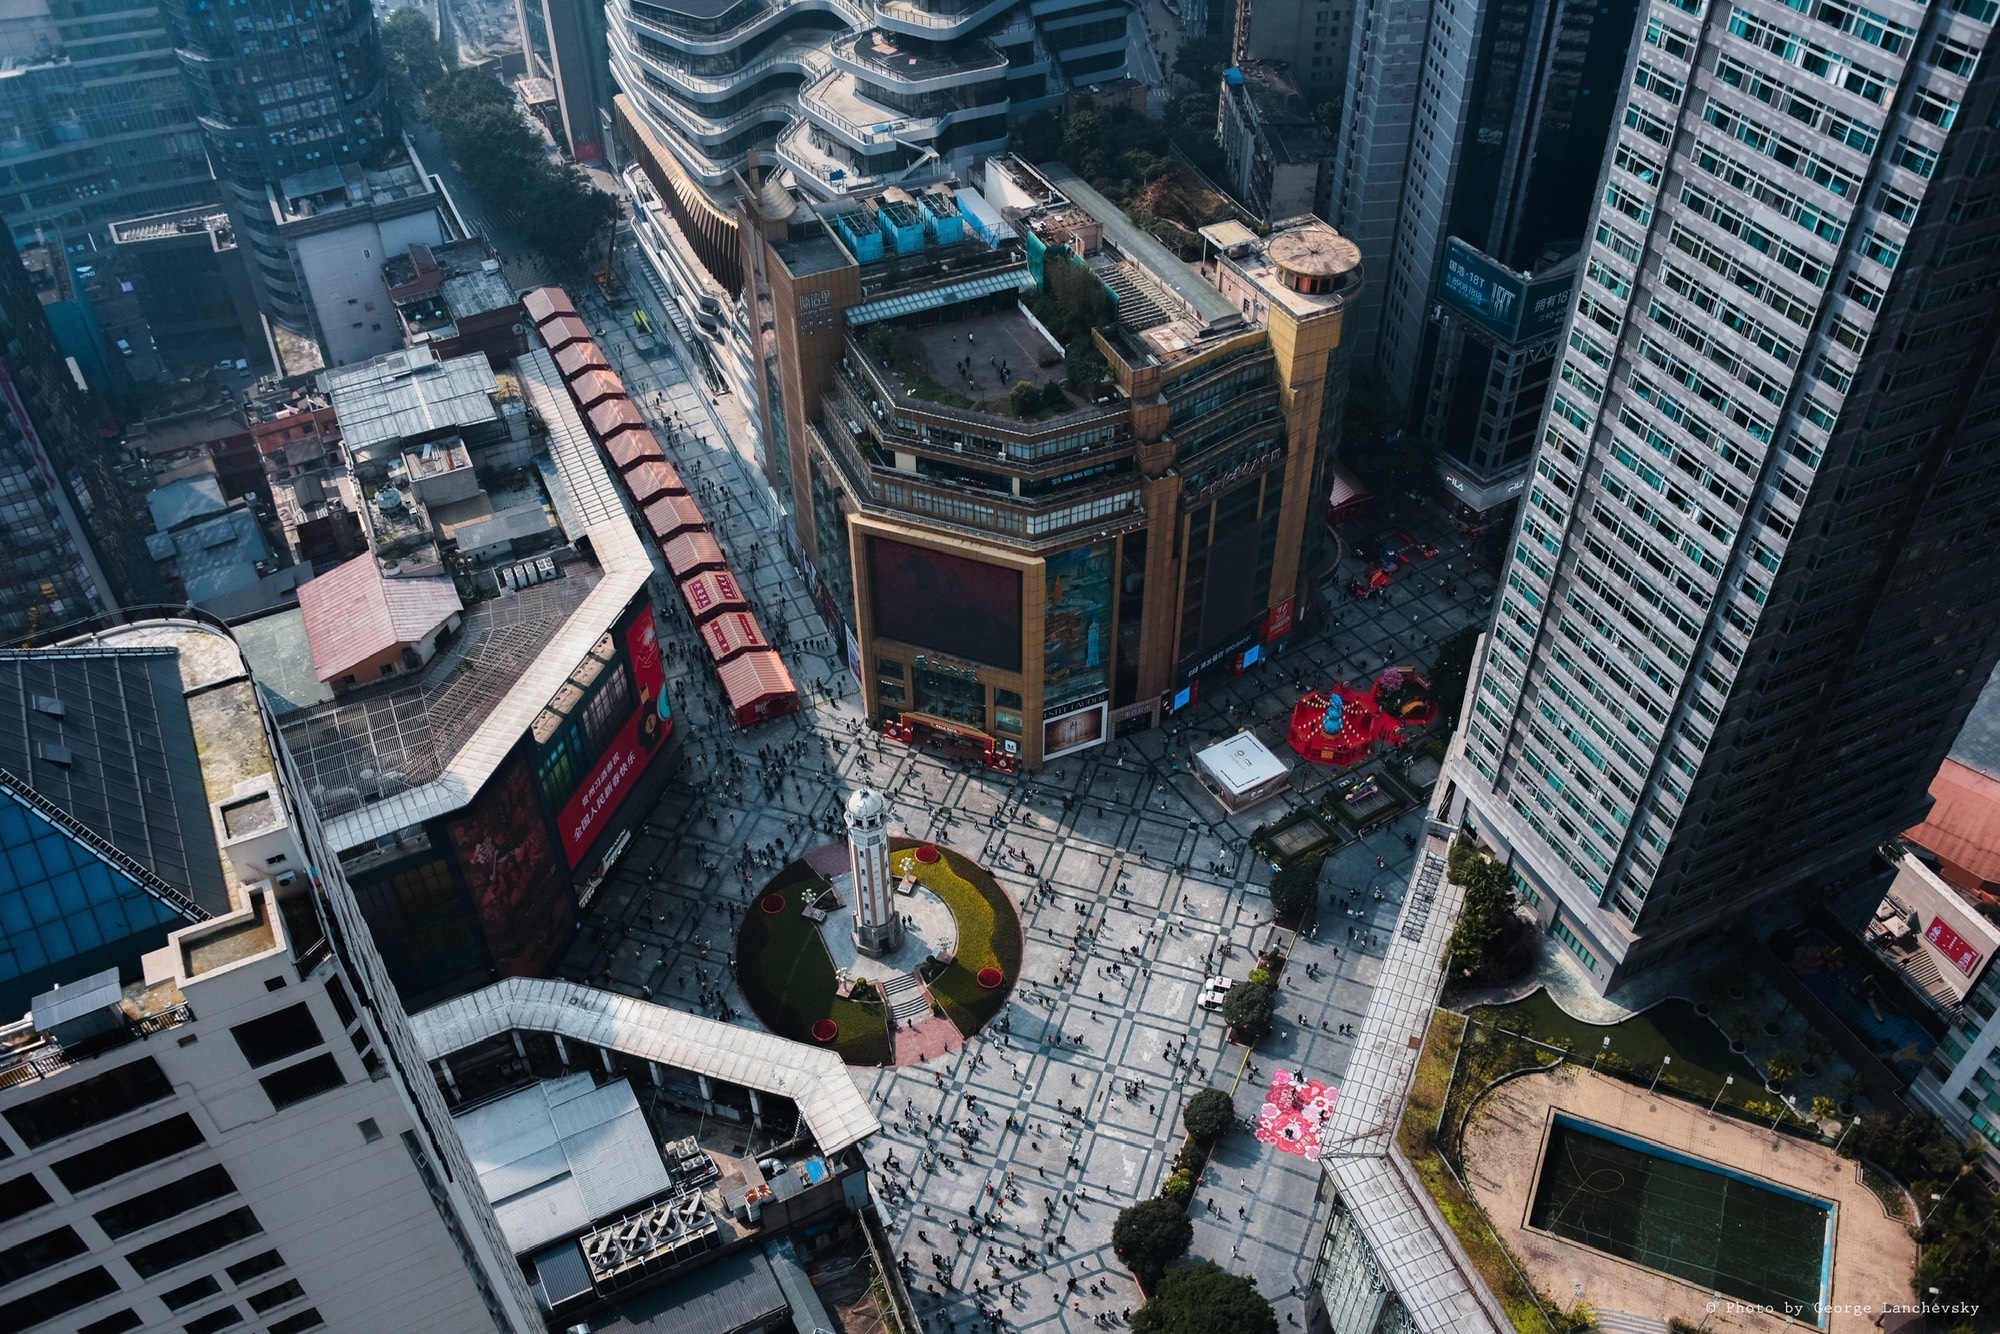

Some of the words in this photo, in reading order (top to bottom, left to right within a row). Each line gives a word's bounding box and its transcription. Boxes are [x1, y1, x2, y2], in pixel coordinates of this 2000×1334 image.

[1446, 473, 1464, 492] FILA
[574, 750, 636, 842] 全国人民新春快乐
